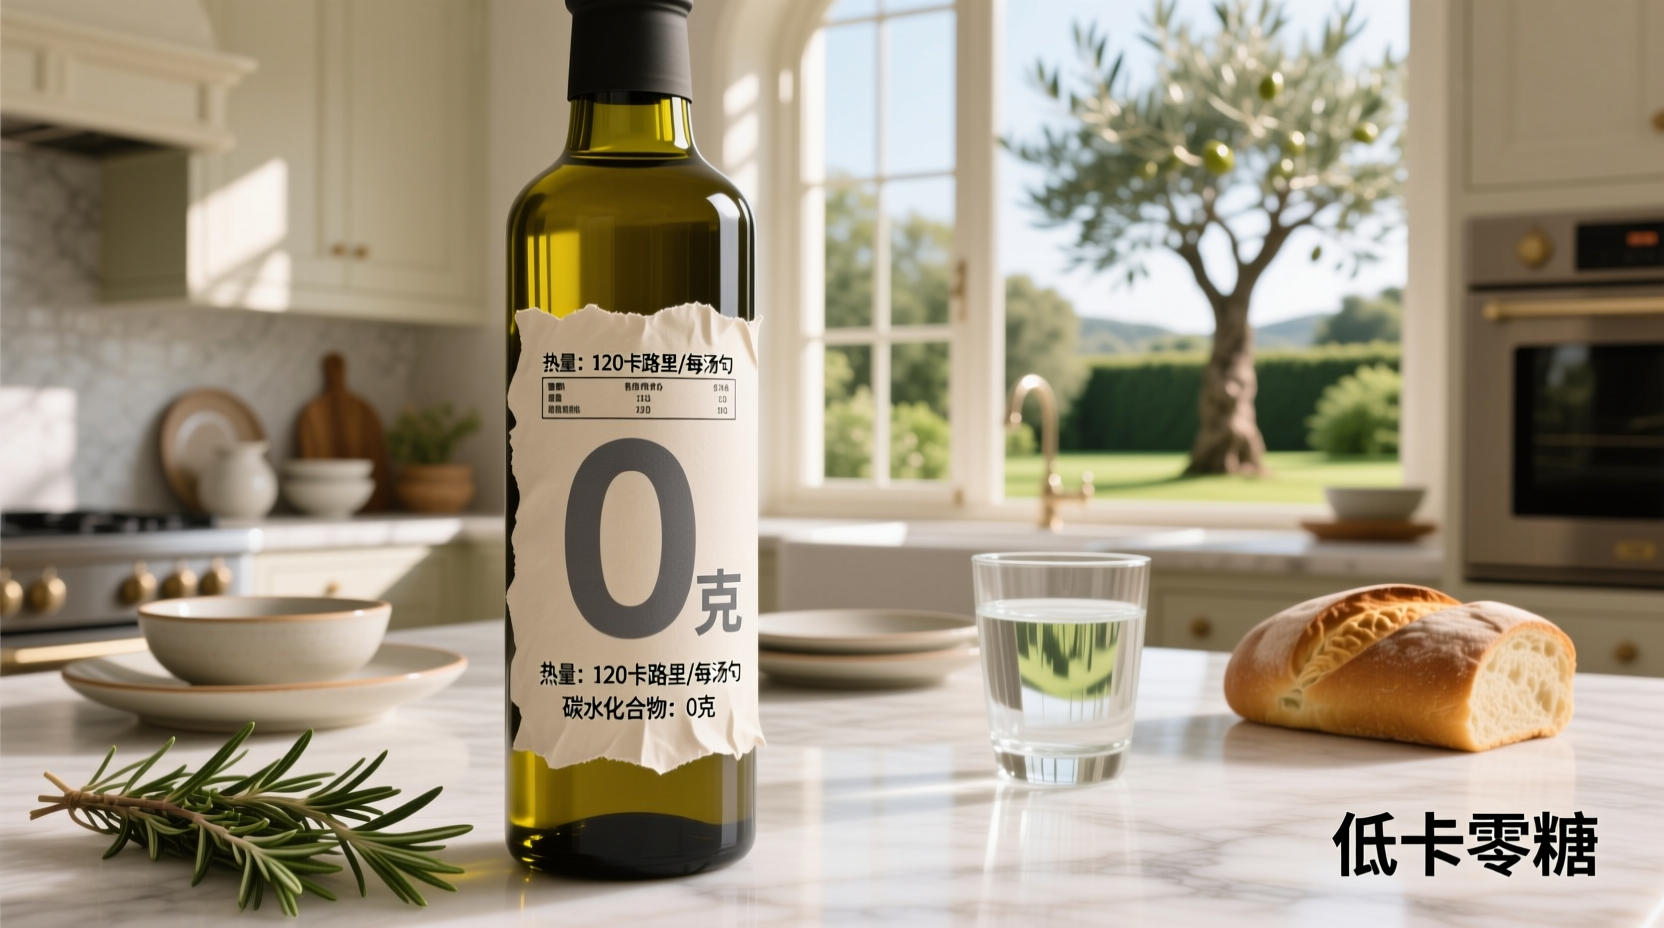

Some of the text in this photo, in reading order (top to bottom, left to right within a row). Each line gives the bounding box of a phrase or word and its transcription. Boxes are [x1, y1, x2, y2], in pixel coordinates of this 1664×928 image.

[540, 660, 742, 687] 热量：120卡路里/每汤勺
[562, 694, 716, 720] 碳水化合物：0克
